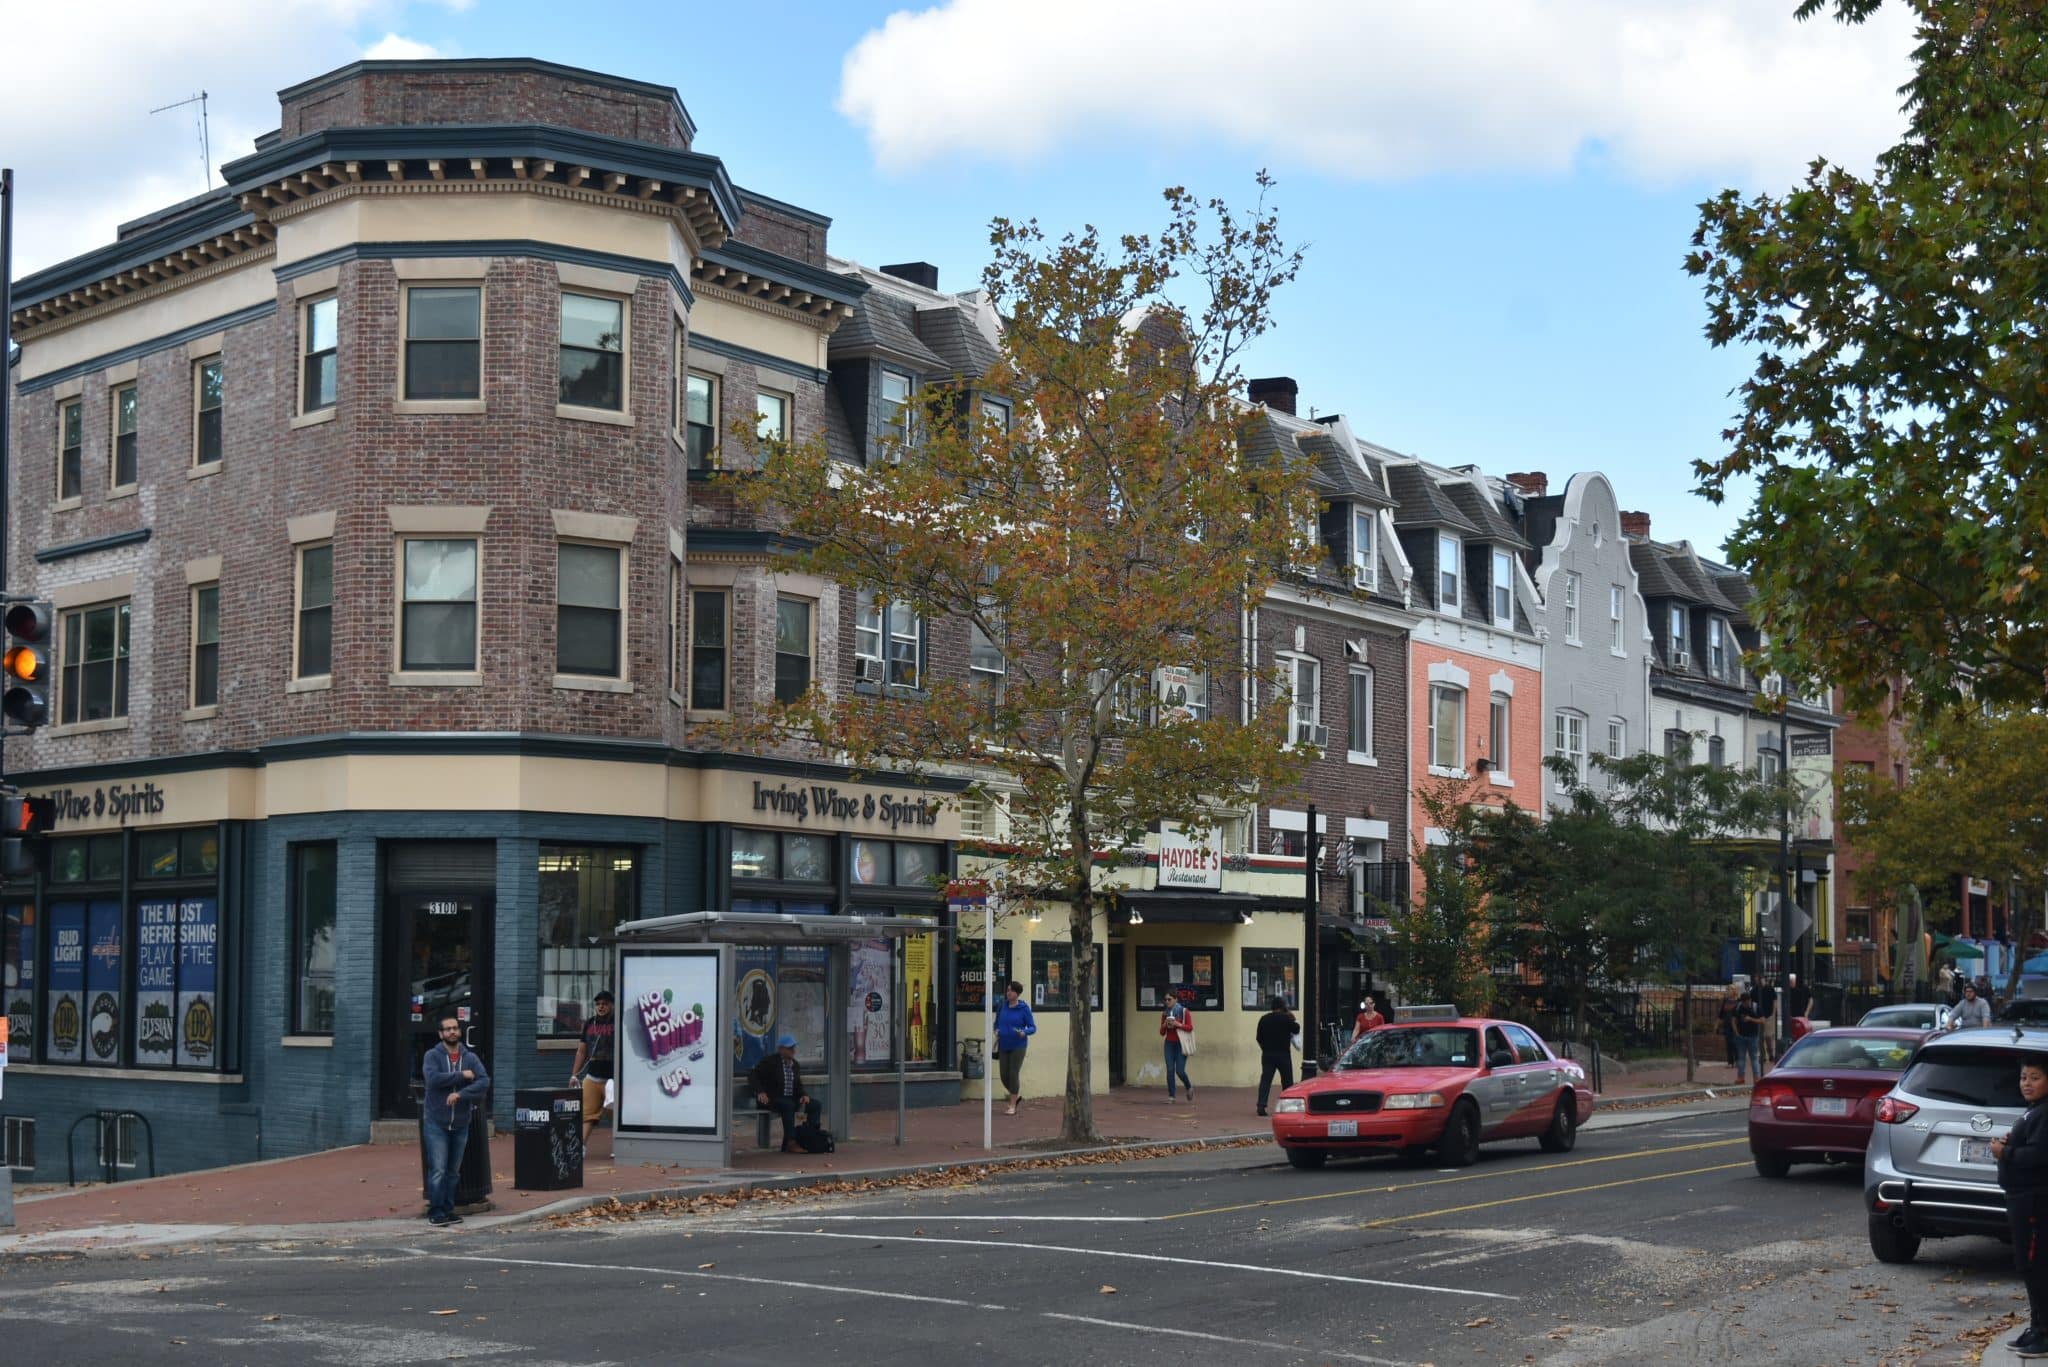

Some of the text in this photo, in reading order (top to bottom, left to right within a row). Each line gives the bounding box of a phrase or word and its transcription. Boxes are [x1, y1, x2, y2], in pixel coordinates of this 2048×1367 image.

[51, 782, 165, 824] Wine & Spirits
[752, 780, 937, 830] Irving Wine & Spirits
[1161, 847, 1218, 871] HAYDEES
[1167, 867, 1207, 884] Restaurant
[141, 903, 203, 923] THE MOST
[430, 902, 457, 914] 3100
[58, 930, 79, 945] BUD
[140, 924, 216, 945] REFRESHING
[55, 946, 82, 961] LIGHT
[140, 946, 166, 965] PLAY
[192, 945, 213, 964] THE
[140, 967, 175, 986] GAME.
[639, 991, 661, 1010] NO
[1178, 990, 1196, 1001] PEN
[643, 1003, 670, 1025] MO
[141, 1017, 173, 1040] ELYSIAN
[648, 1010, 700, 1041] FOMO.
